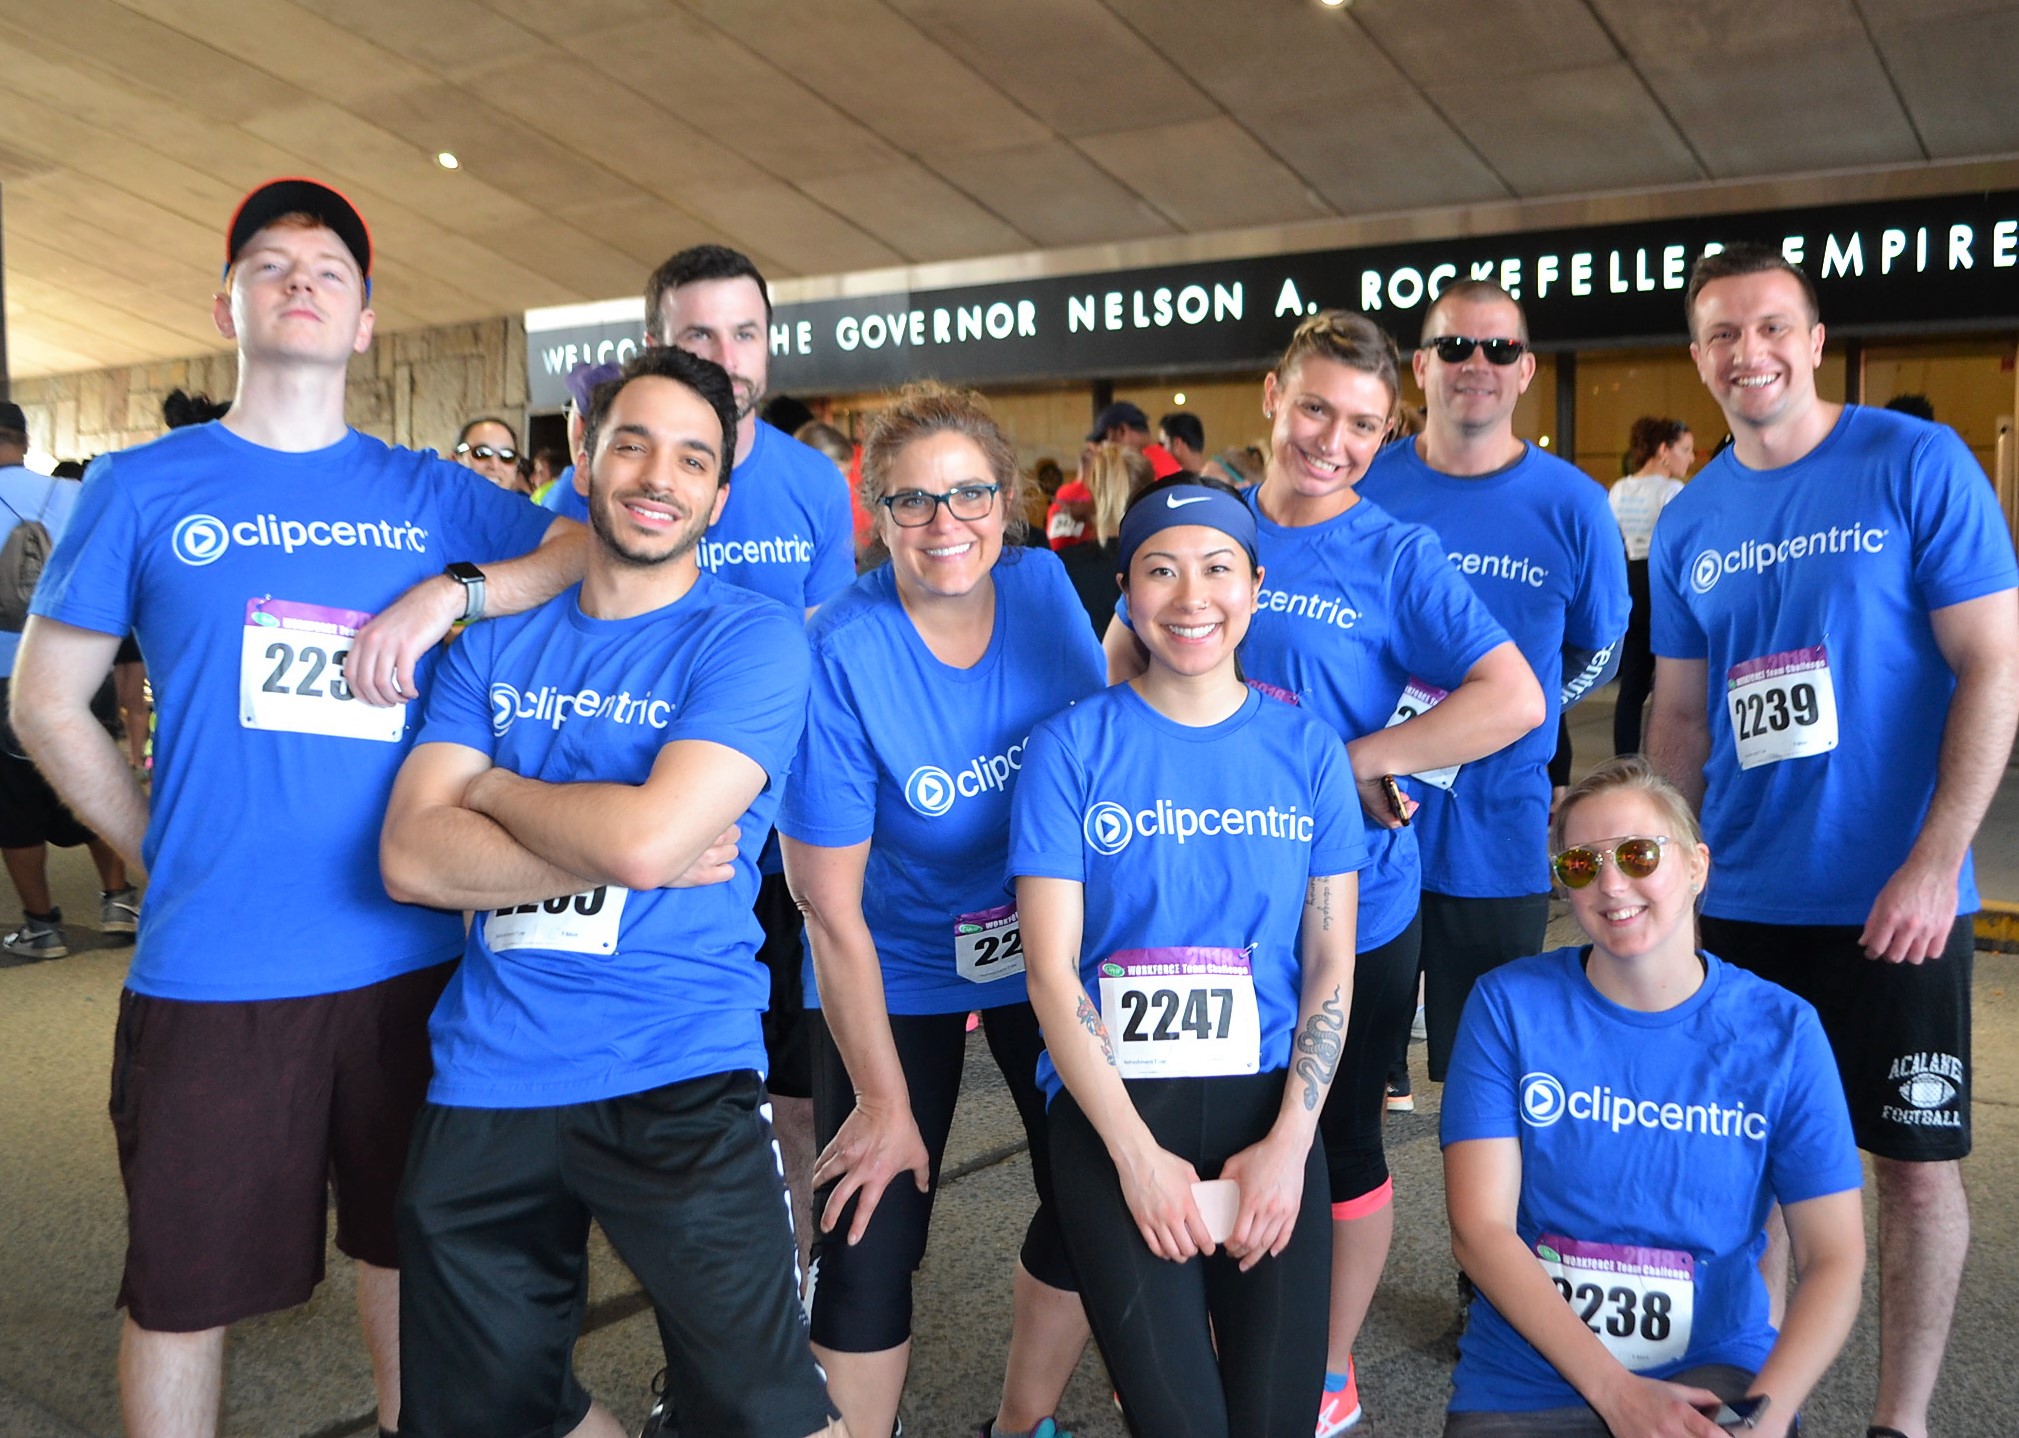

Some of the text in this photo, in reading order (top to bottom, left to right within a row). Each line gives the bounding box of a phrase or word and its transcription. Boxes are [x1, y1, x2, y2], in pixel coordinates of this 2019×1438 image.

[541, 338, 646, 375] WELCO
[770, 321, 812, 356] HE
[836, 300, 1036, 351] GOVERNOR
[1068, 281, 1243, 333] NELSON
[1274, 278, 1317, 318] A.
[1782, 220, 2018, 279] EMPIRE
[232, 514, 426, 554] clipcentric
[696, 534, 811, 574] lipcentric
[1723, 522, 1884, 574] clipcentric
[1447, 552, 1544, 587] centric
[1257, 589, 1357, 629] centric
[262, 643, 355, 701] 223
[515, 686, 671, 730] clipentric
[1735, 682, 1819, 741] 2239
[957, 736, 1030, 797] clipc
[1135, 799, 1314, 844] clipcentric
[974, 929, 1023, 967] 22
[1127, 963, 1180, 976] WORKFORCE
[1121, 988, 1234, 1042] 2247
[1568, 1085, 1768, 1140] clipcentric
[1881, 1104, 1962, 1127] FOOTBALL
[1562, 1253, 1615, 1271] WORKFORCE
[1617, 1261, 1642, 1275] Team
[1643, 1264, 1691, 1280] Challenge
